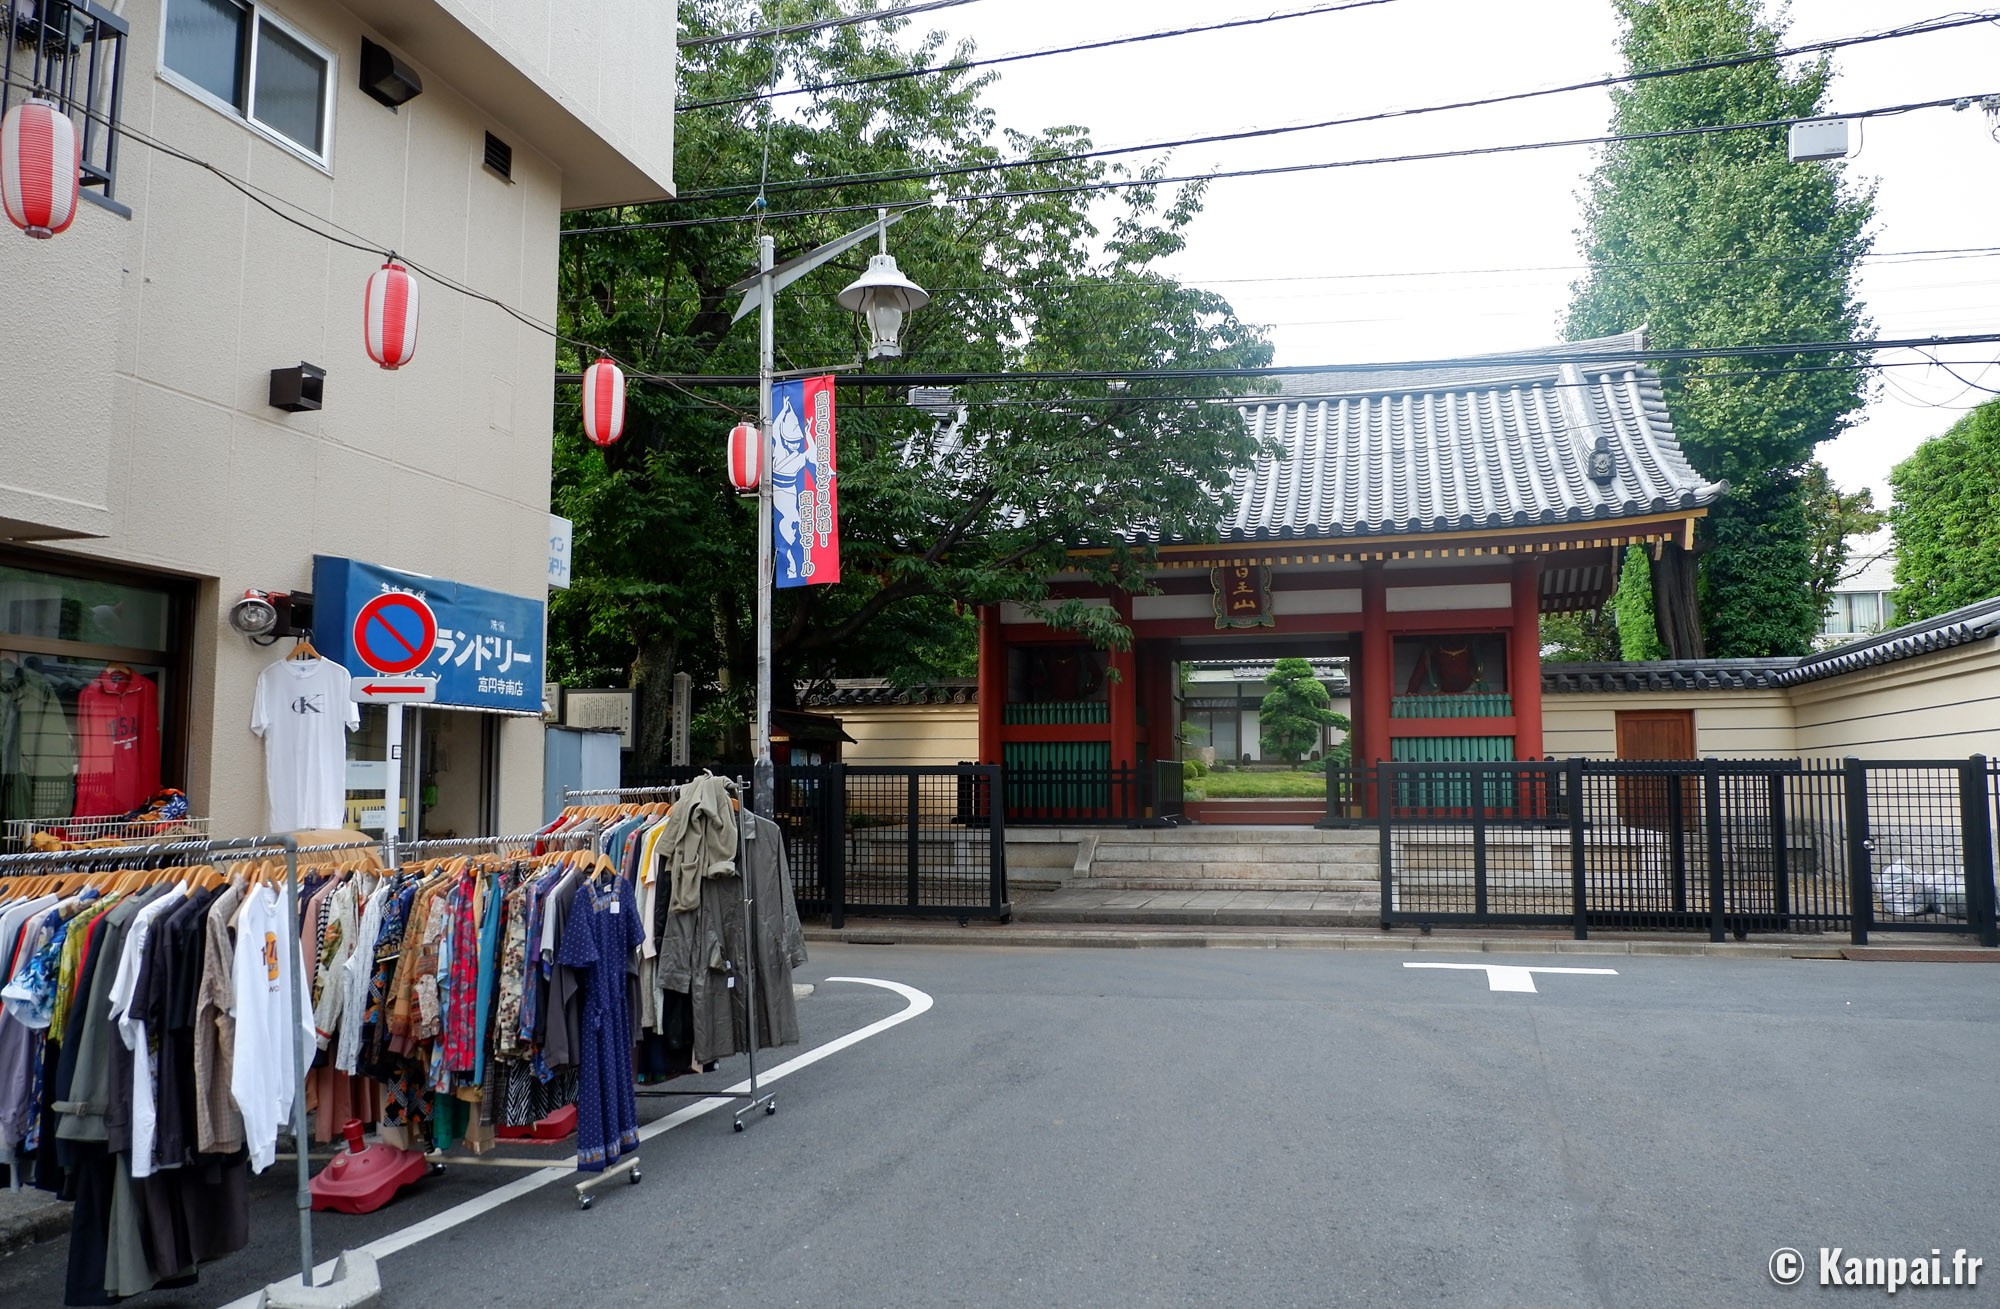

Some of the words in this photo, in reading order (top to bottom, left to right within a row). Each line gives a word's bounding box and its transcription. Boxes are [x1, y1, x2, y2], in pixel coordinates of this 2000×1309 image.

[799, 490, 815, 577] 商店街セール
[477, 675, 524, 697] 高円寺南店
